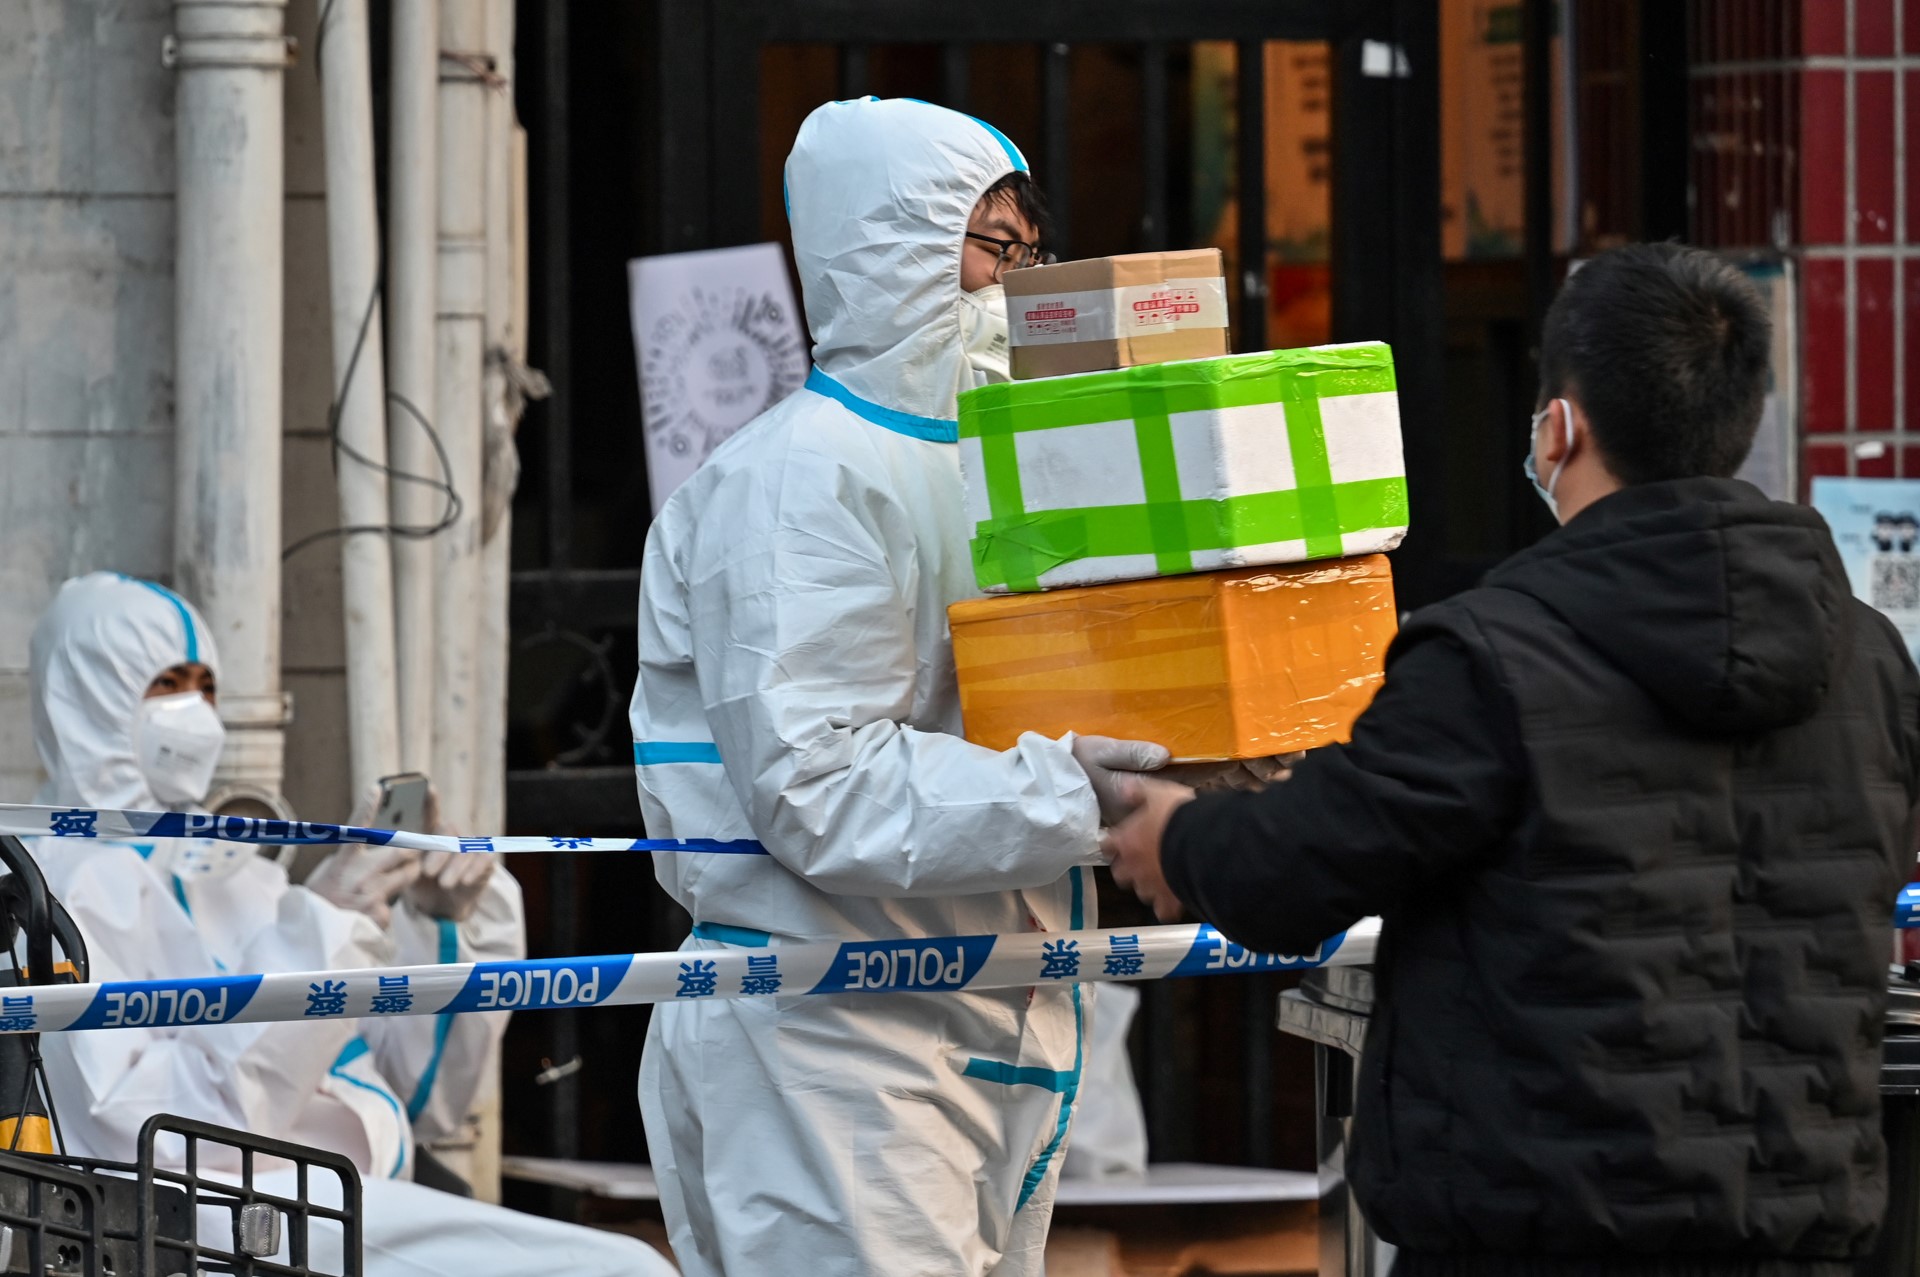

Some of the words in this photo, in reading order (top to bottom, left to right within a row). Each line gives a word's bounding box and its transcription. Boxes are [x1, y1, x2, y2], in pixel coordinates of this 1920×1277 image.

[676, 954, 783, 998] 警察
[845, 946, 964, 989] POLICE
[1039, 934, 1145, 979] 警察
[104, 987, 228, 1027] POLICE
[304, 974, 413, 1017] 警察
[477, 967, 599, 1008] POLICE
[0, 995, 37, 1031] 警
